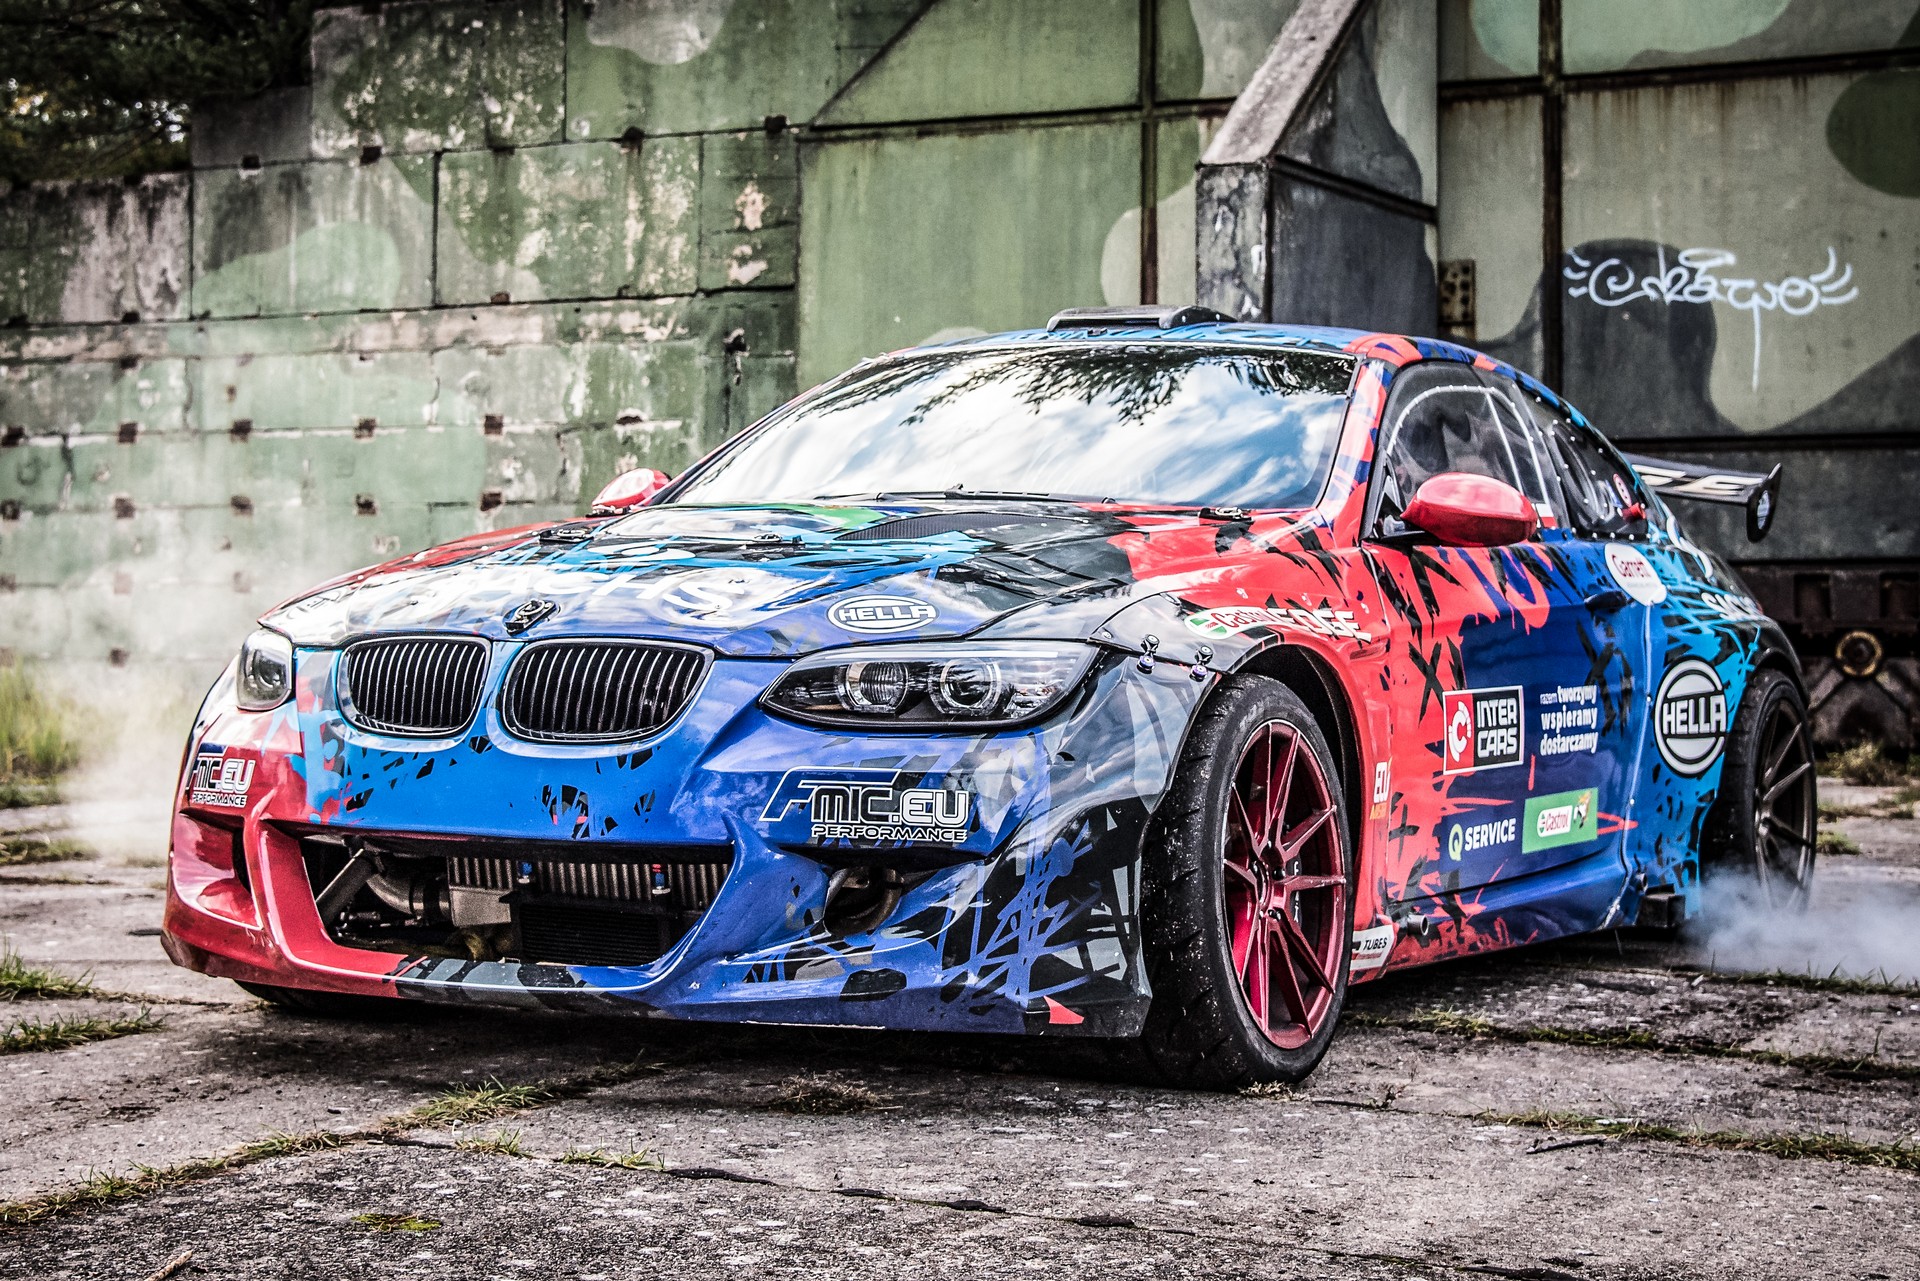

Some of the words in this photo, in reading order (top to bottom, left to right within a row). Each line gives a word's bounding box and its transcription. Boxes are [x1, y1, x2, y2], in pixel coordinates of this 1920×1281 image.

[837, 602, 937, 623] HELLA
[1557, 684, 1598, 705] tworzymy
[1476, 697, 1518, 728] INTER
[1541, 704, 1598, 734] wspieramy
[1662, 694, 1727, 735] HELLA
[1477, 726, 1518, 758] CARS
[1540, 731, 1599, 757] dostarczamy
[191, 791, 248, 808] PERFORMANCE
[811, 823, 968, 843] PERFORMANCE
[1464, 817, 1517, 852] SERVICE
[1363, 936, 1388, 951] TUBES
